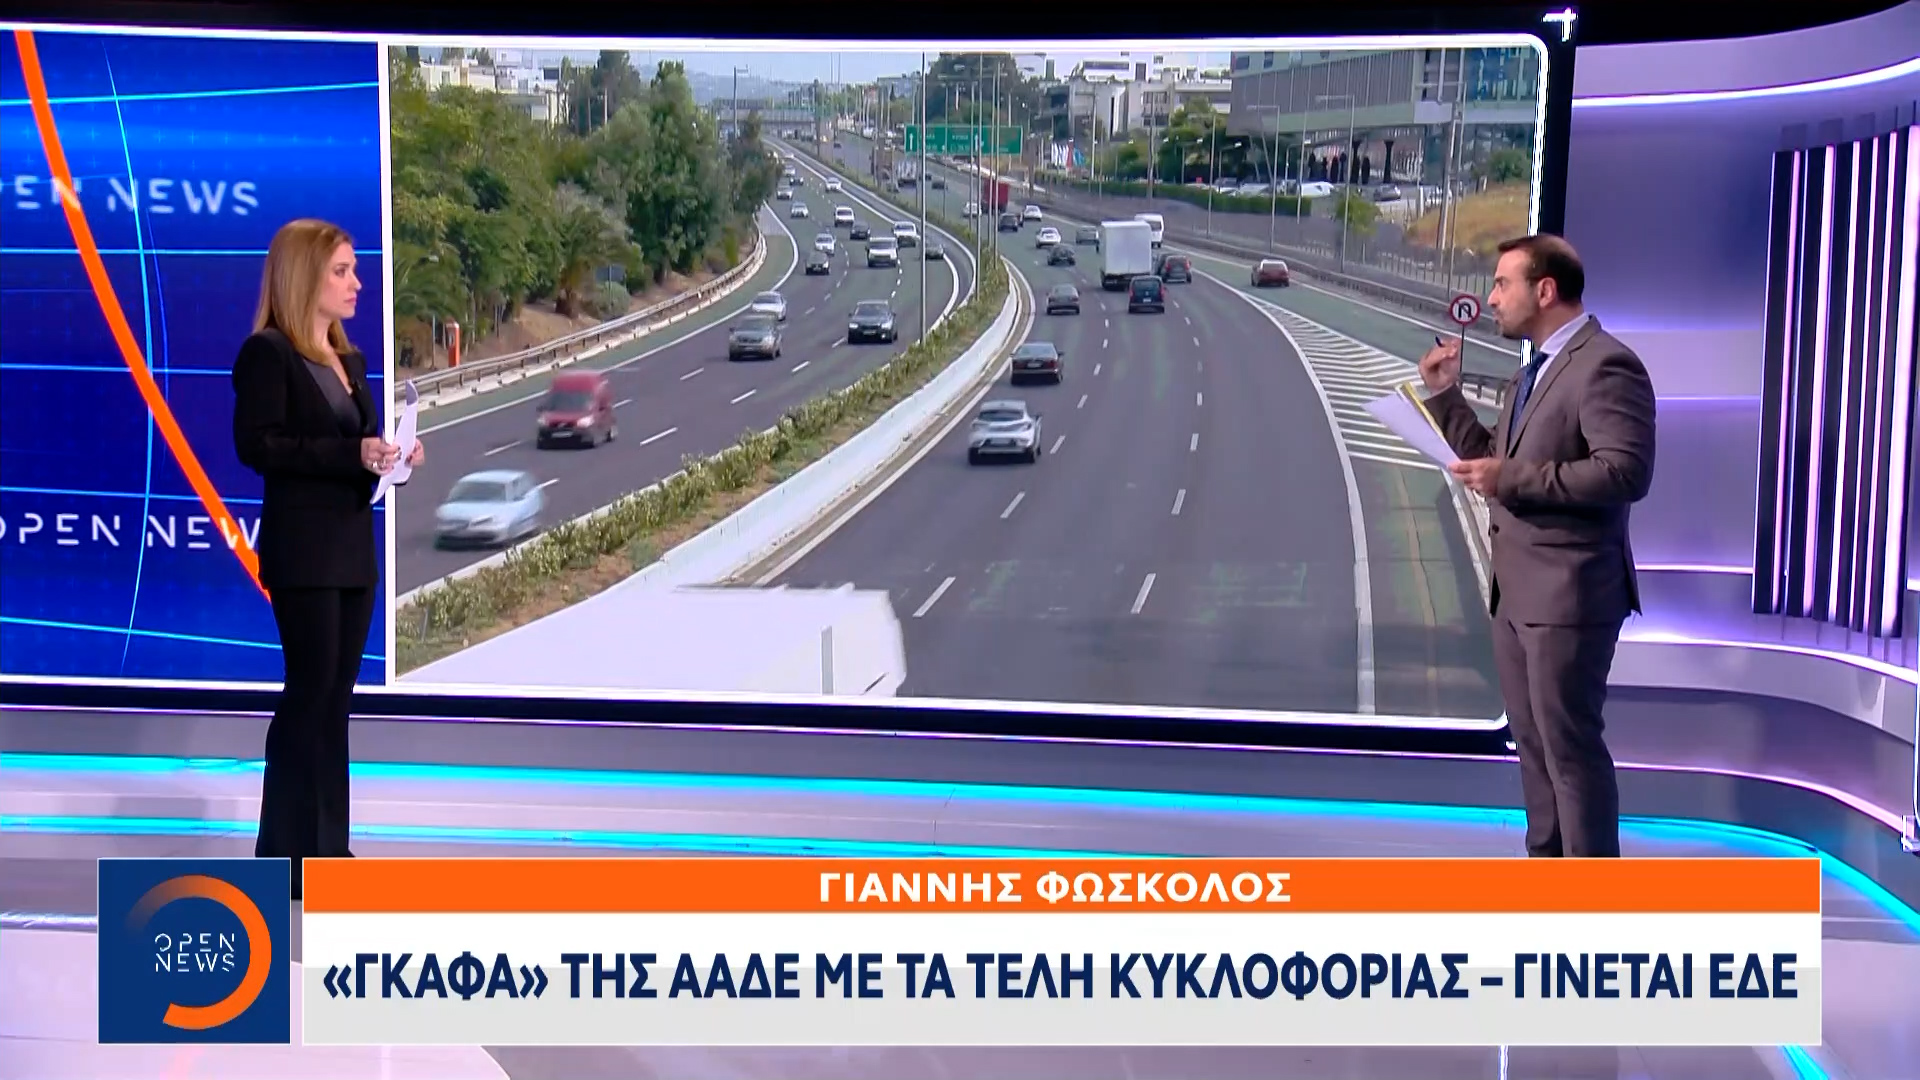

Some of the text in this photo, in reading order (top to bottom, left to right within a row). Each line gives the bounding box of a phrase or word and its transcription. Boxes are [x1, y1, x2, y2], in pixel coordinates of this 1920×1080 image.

[0, 175, 258, 215] EN NEWS
[0, 512, 261, 550] PEN NEW
